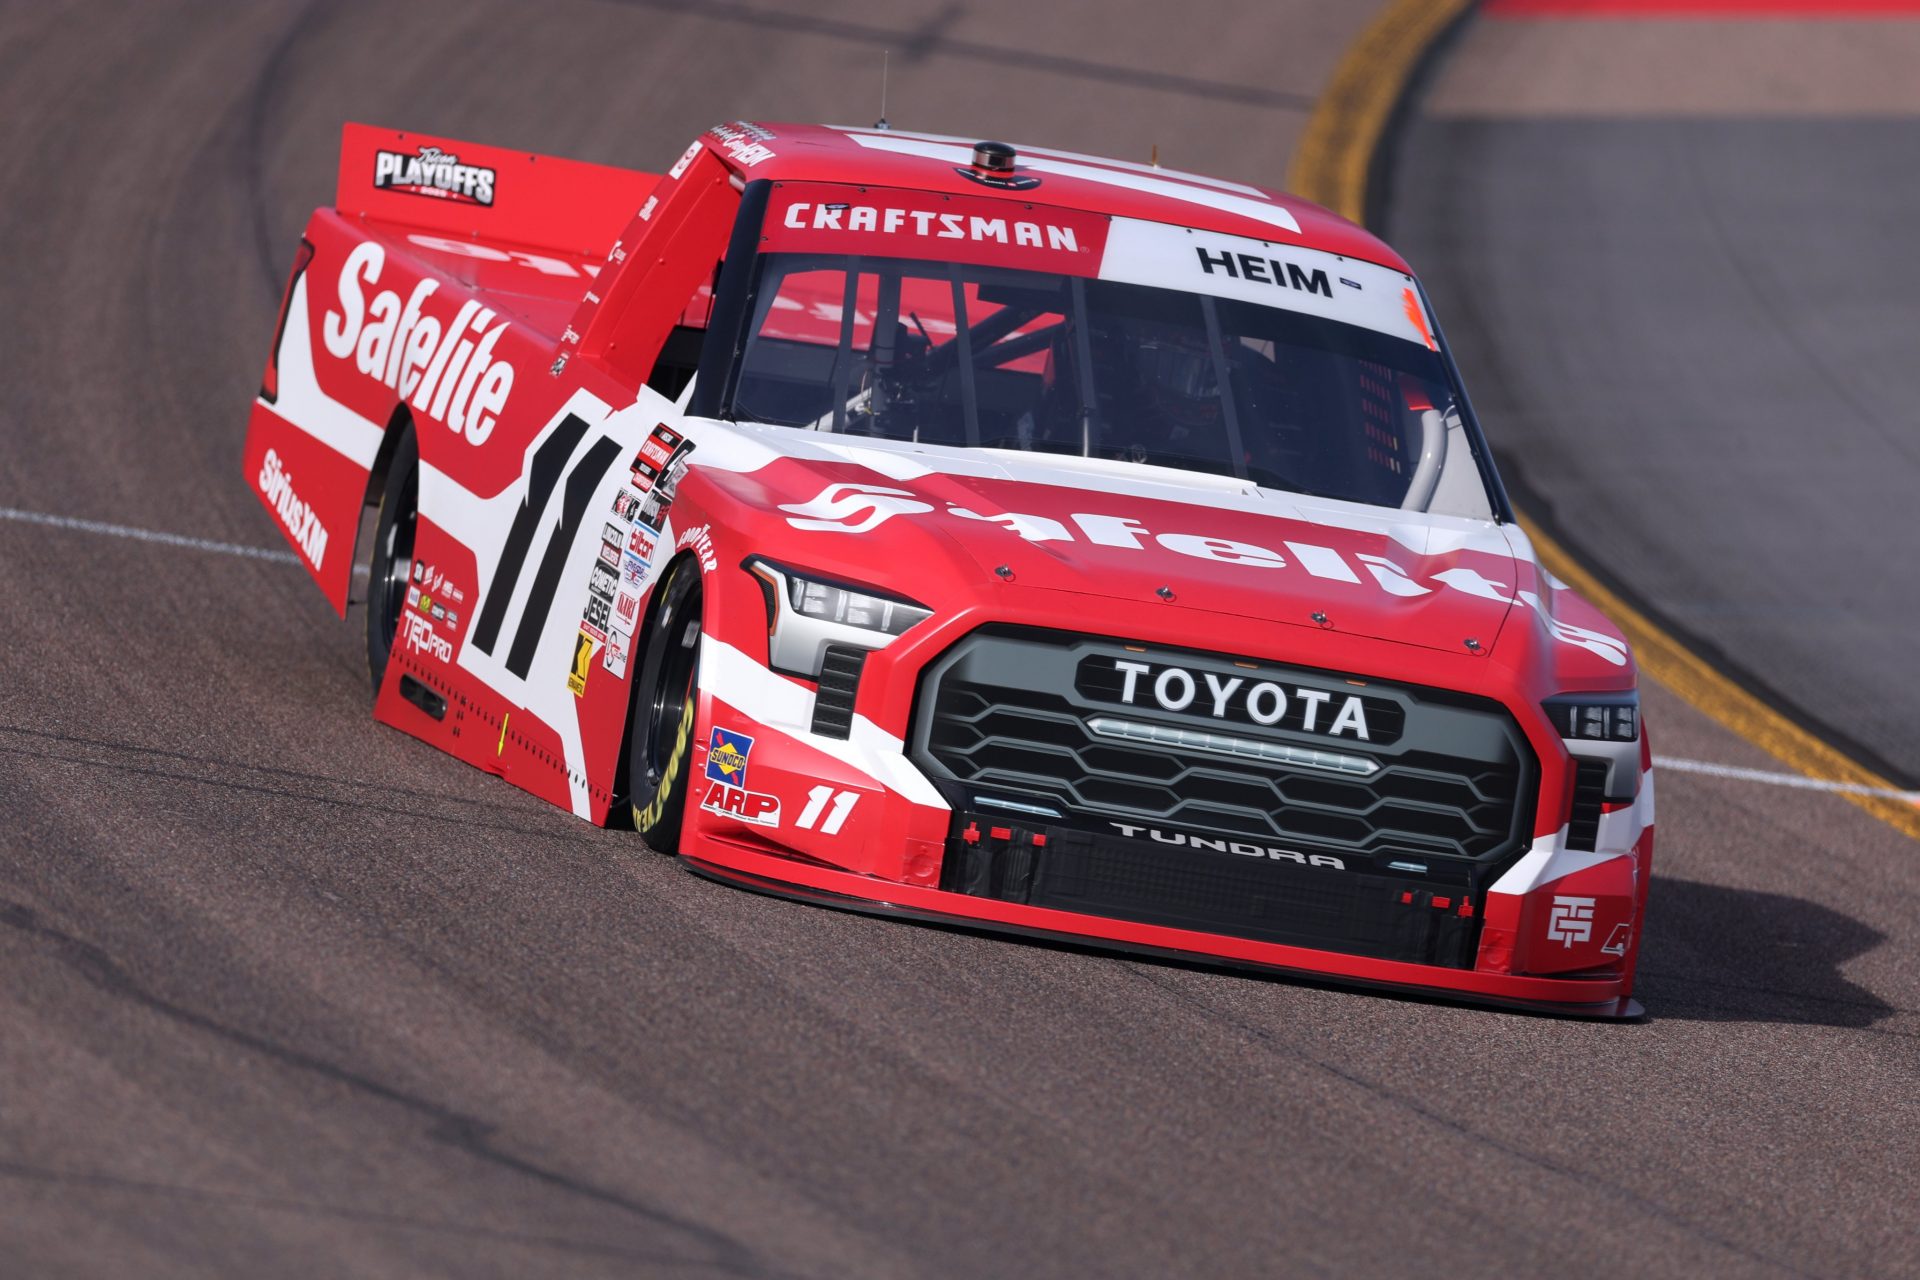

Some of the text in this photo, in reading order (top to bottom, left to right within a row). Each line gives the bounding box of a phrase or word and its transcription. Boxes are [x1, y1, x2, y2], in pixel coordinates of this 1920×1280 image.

[375, 151, 495, 205] PLAYOFFS
[784, 203, 1079, 252] CRAFTSMAN
[1195, 246, 1334, 299] HEIM
[323, 241, 515, 446] Safelite
[258, 448, 329, 572] SiriusXM
[471, 412, 623, 682] 11
[676, 523, 717, 574] GOODYEAR
[591, 565, 619, 598] COMETIC
[583, 595, 611, 634] JESEL
[1115, 660, 1370, 741] TOYOTA
[711, 748, 745, 770] SUNOCO
[704, 782, 779, 819] ARP
[795, 785, 861, 836] 11
[1109, 822, 1346, 871] TUNDRA
